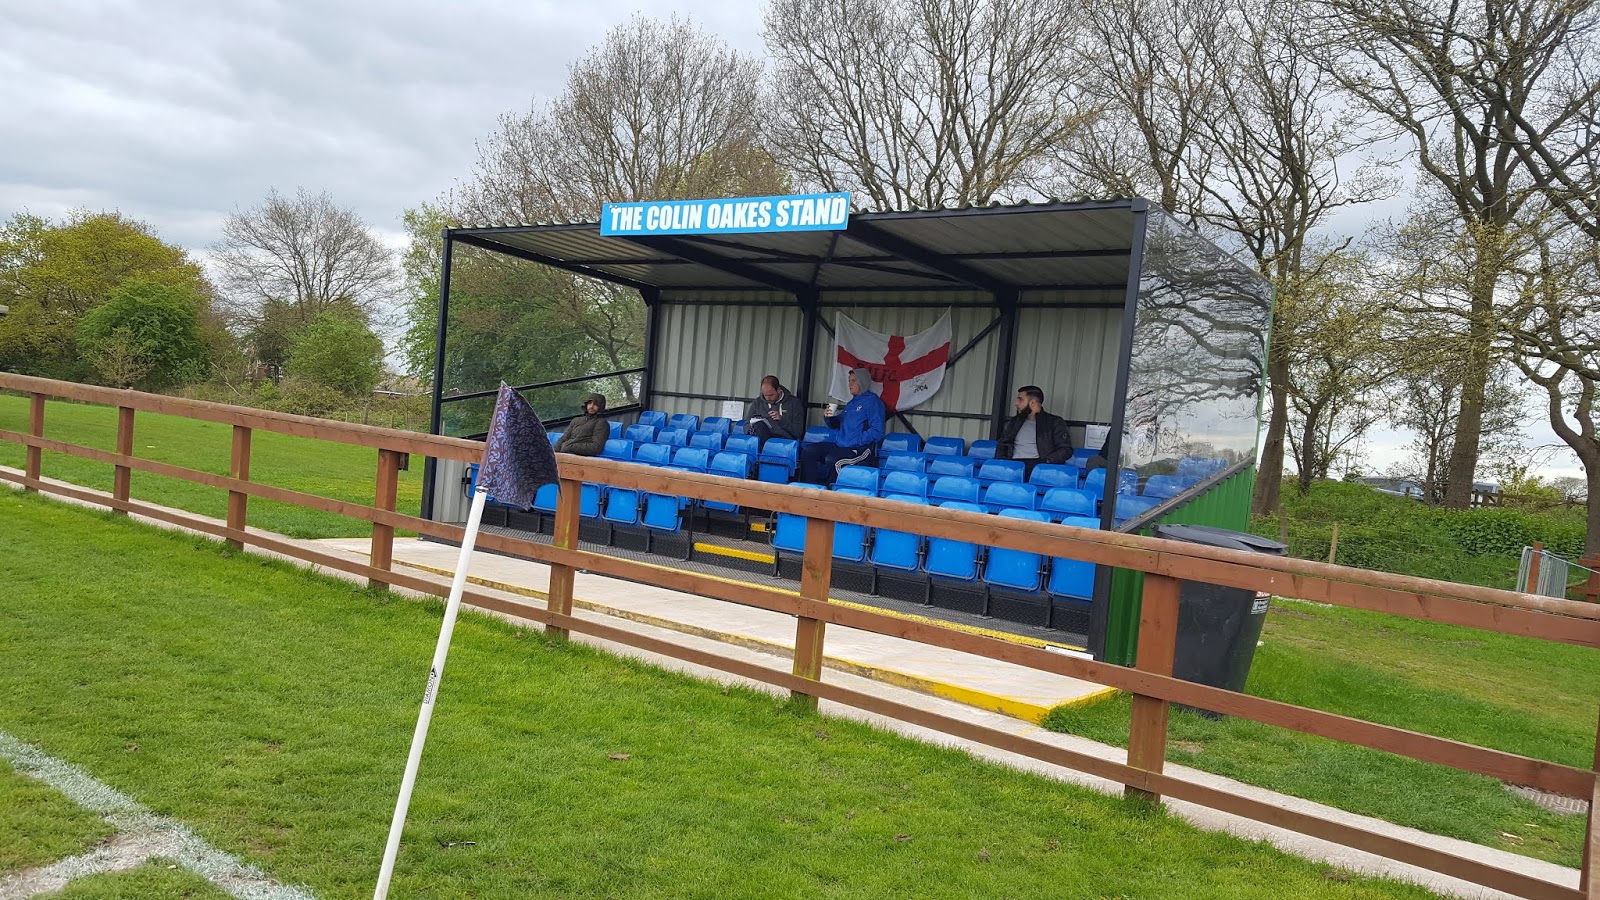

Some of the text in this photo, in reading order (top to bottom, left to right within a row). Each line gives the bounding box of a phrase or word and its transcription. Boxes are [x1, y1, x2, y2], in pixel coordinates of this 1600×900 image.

[610, 198, 847, 231] THE COLIN OAKES STAND
